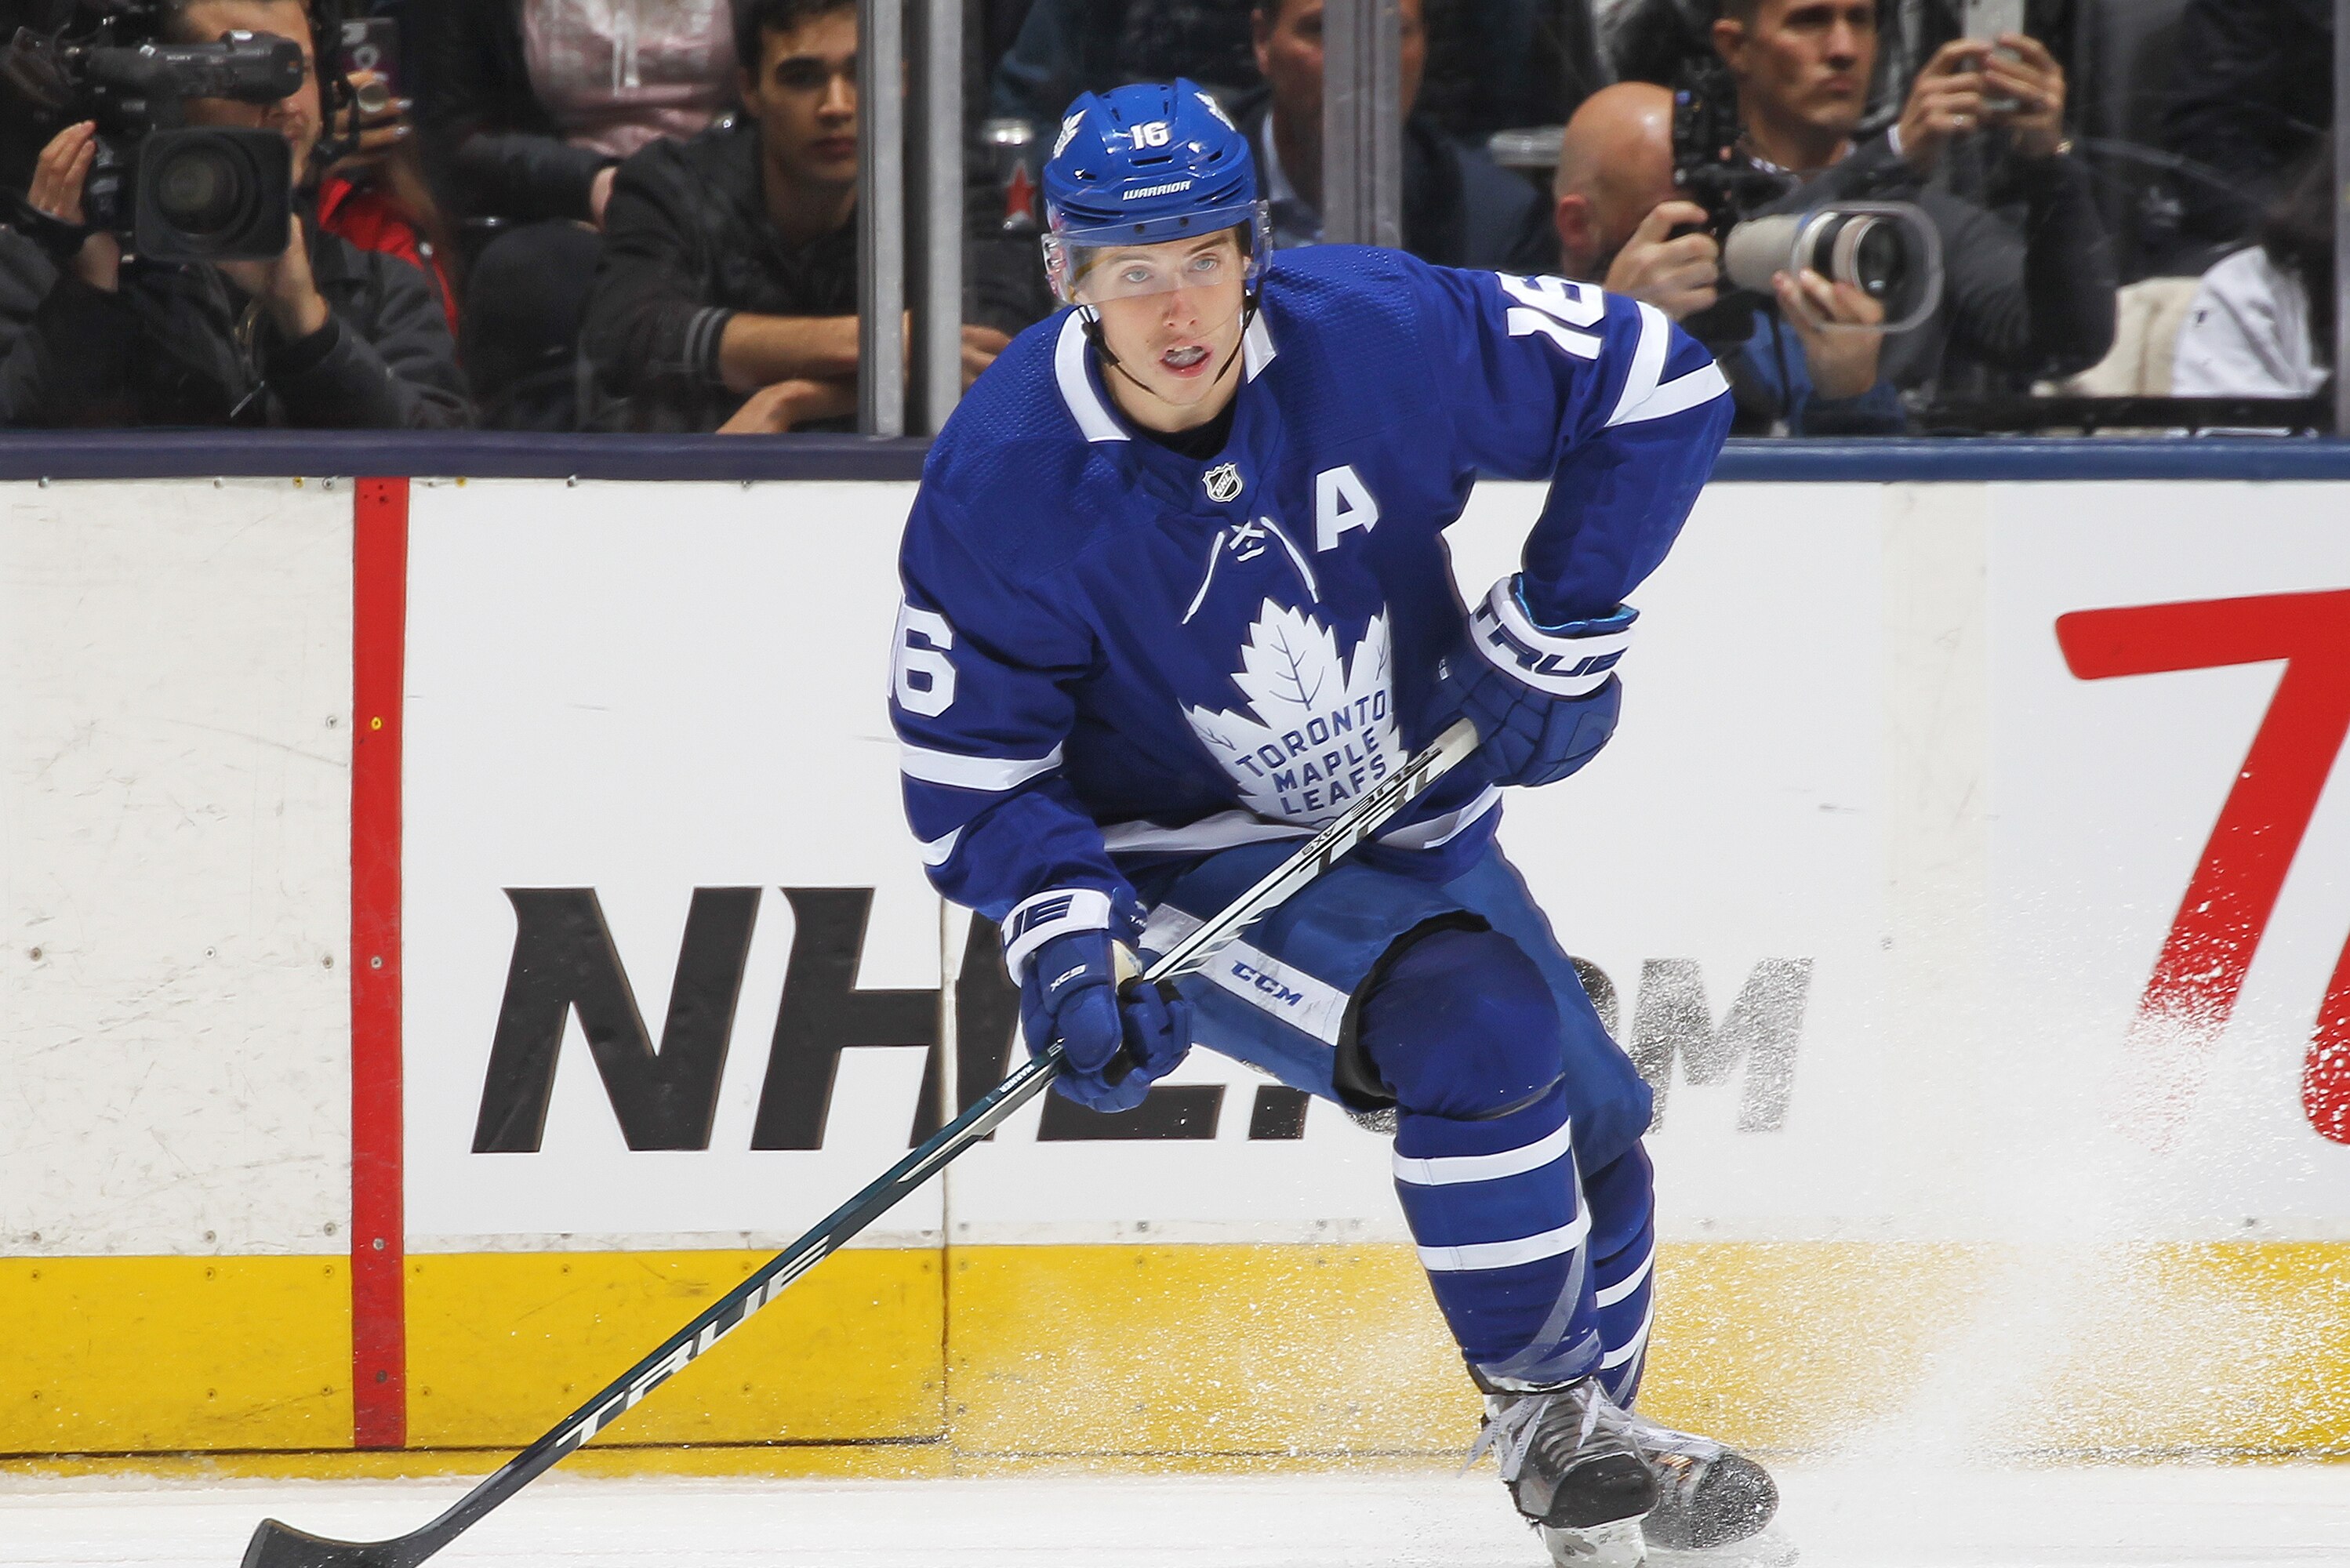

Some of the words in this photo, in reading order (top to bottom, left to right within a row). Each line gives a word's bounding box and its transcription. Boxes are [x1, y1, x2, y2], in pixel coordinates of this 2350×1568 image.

[1130, 121, 1171, 150] 16
[1122, 180, 1193, 201] WARRIOR
[1495, 270, 1606, 361] 16
[1317, 465, 1379, 553] A
[887, 594, 957, 718] 6
[1476, 593, 1629, 677] TRUE
[1234, 688, 1386, 779] TORONTO
[1272, 727, 1380, 794] MAPLE
[1279, 753, 1387, 816] LEAFS
[1348, 744, 1444, 819] RUE
[1050, 964, 1087, 993] XC9
[1230, 960, 1304, 1007] CCM
[555, 1234, 830, 1448] TRUE
